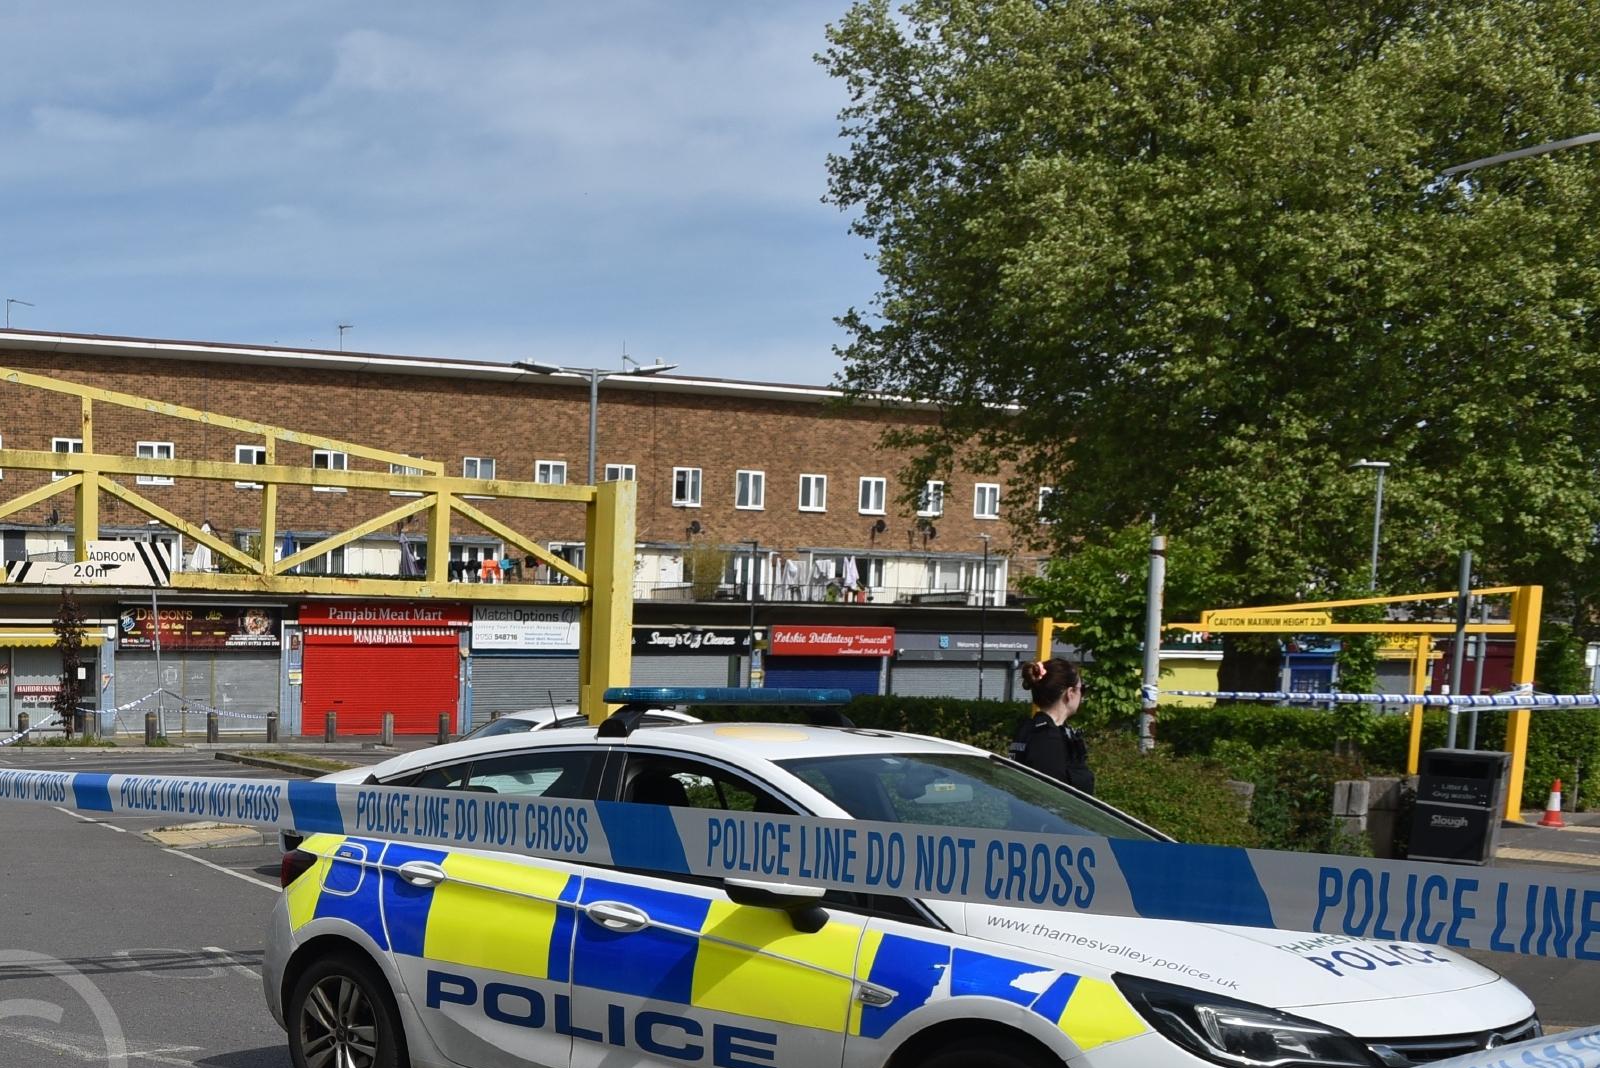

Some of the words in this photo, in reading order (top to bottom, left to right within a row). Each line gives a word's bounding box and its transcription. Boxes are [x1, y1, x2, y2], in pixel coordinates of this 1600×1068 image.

[73, 564, 107, 578] 2.0m
[328, 607, 376, 624] Panjabi
[379, 607, 410, 621] Meat
[412, 608, 442, 621] Mart
[475, 608, 559, 624] MatchOptions
[1214, 617, 1245, 626] CAUTION
[1247, 617, 1281, 626] MAXIMUM
[1283, 617, 1308, 626] HEIGHT
[774, 631, 807, 644] Polskie
[13, 772, 37, 799] NOT
[34, 773, 70, 804] CROSS
[120, 777, 161, 811] POLICE
[160, 779, 189, 814] LINE
[189, 781, 208, 816] DO
[209, 783, 236, 818] NOT
[236, 784, 281, 823] CROSS
[356, 791, 409, 833] POLICE
[413, 795, 449, 839] LINE
[453, 799, 478, 843] DO
[483, 803, 520, 847] NOT
[525, 804, 588, 854] CROSS
[1431, 814, 1469, 829] Slough
[706, 817, 791, 877] POLICE
[799, 824, 857, 884] LINE
[864, 831, 905, 890] DO
[914, 834, 976, 896] NOT
[984, 839, 1097, 910] CROSS
[1312, 866, 1480, 949] POLICE
[1490, 882, 1600, 961] LINE
[985, 912, 1241, 992] www.thamesvalley.police.uk
[1303, 944, 1452, 977] POLICE
